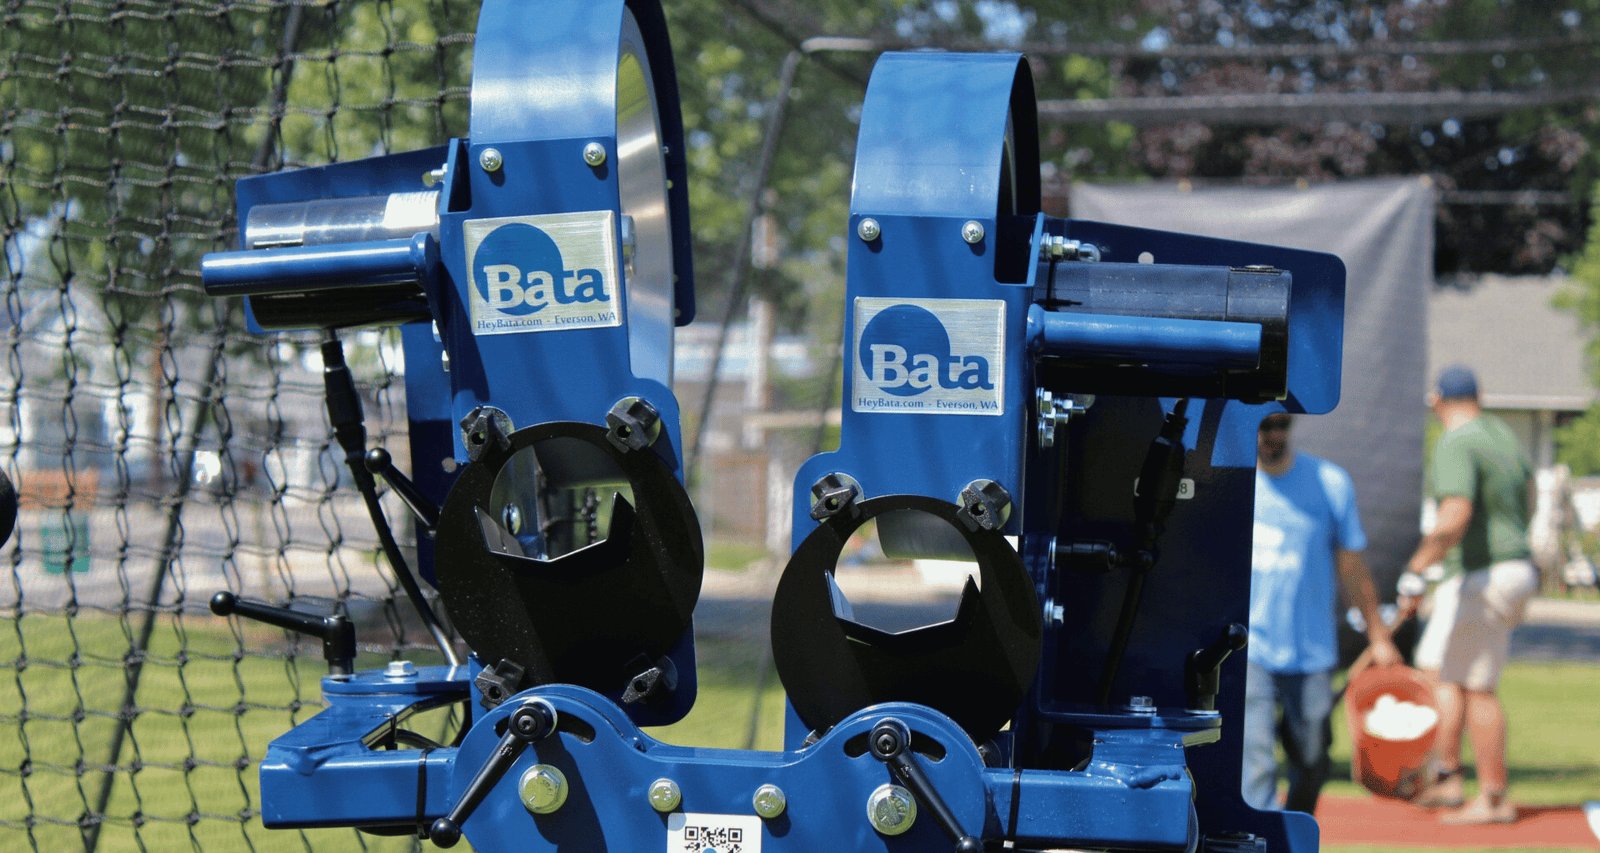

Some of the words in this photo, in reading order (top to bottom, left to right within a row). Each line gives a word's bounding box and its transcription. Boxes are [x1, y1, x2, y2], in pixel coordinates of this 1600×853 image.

[483, 263, 610, 309] Bata
[477, 317, 543, 331] HeyBata.com
[554, 314, 596, 325] Everson,
[598, 311, 616, 322] WA
[870, 343, 994, 391] Bata
[858, 397, 924, 410] HeyBata.com
[936, 399, 978, 410] Everson,
[980, 400, 998, 410] WA
